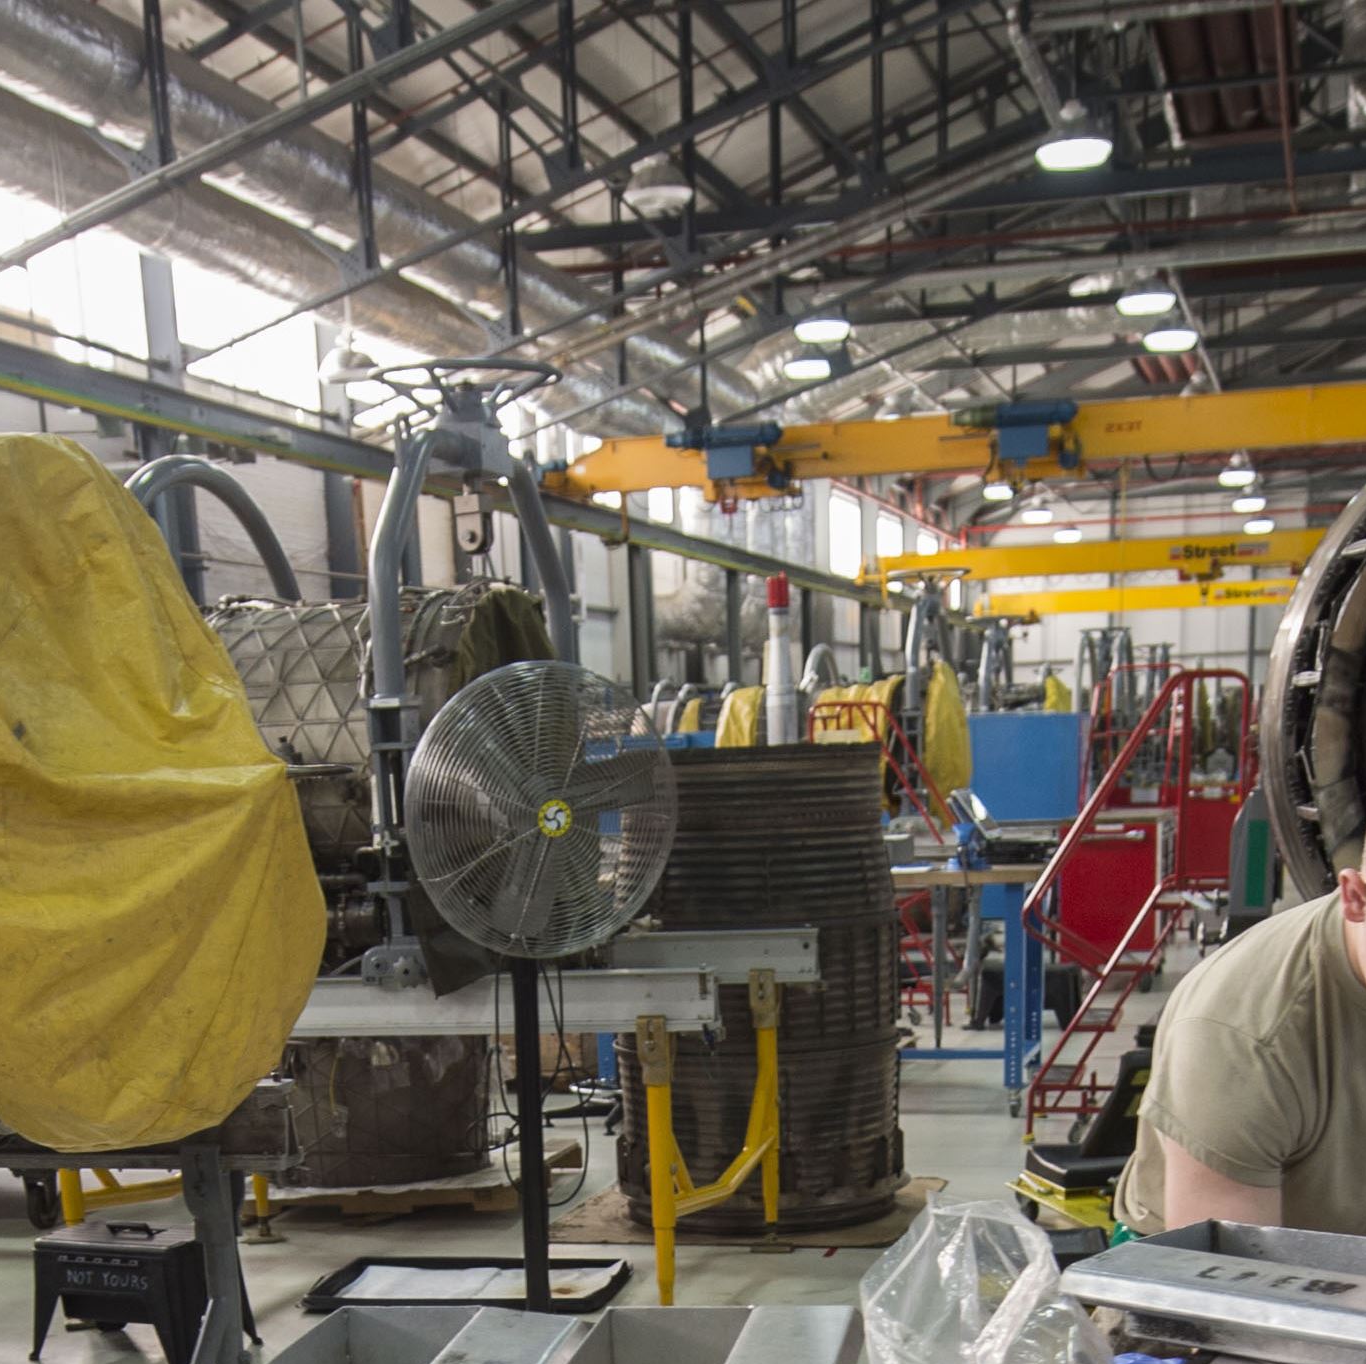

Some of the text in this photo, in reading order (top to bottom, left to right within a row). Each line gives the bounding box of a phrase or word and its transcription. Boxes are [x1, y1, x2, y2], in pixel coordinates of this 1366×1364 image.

[1183, 543, 1236, 560] Street
[66, 1269, 149, 1291] NOT YOURS
